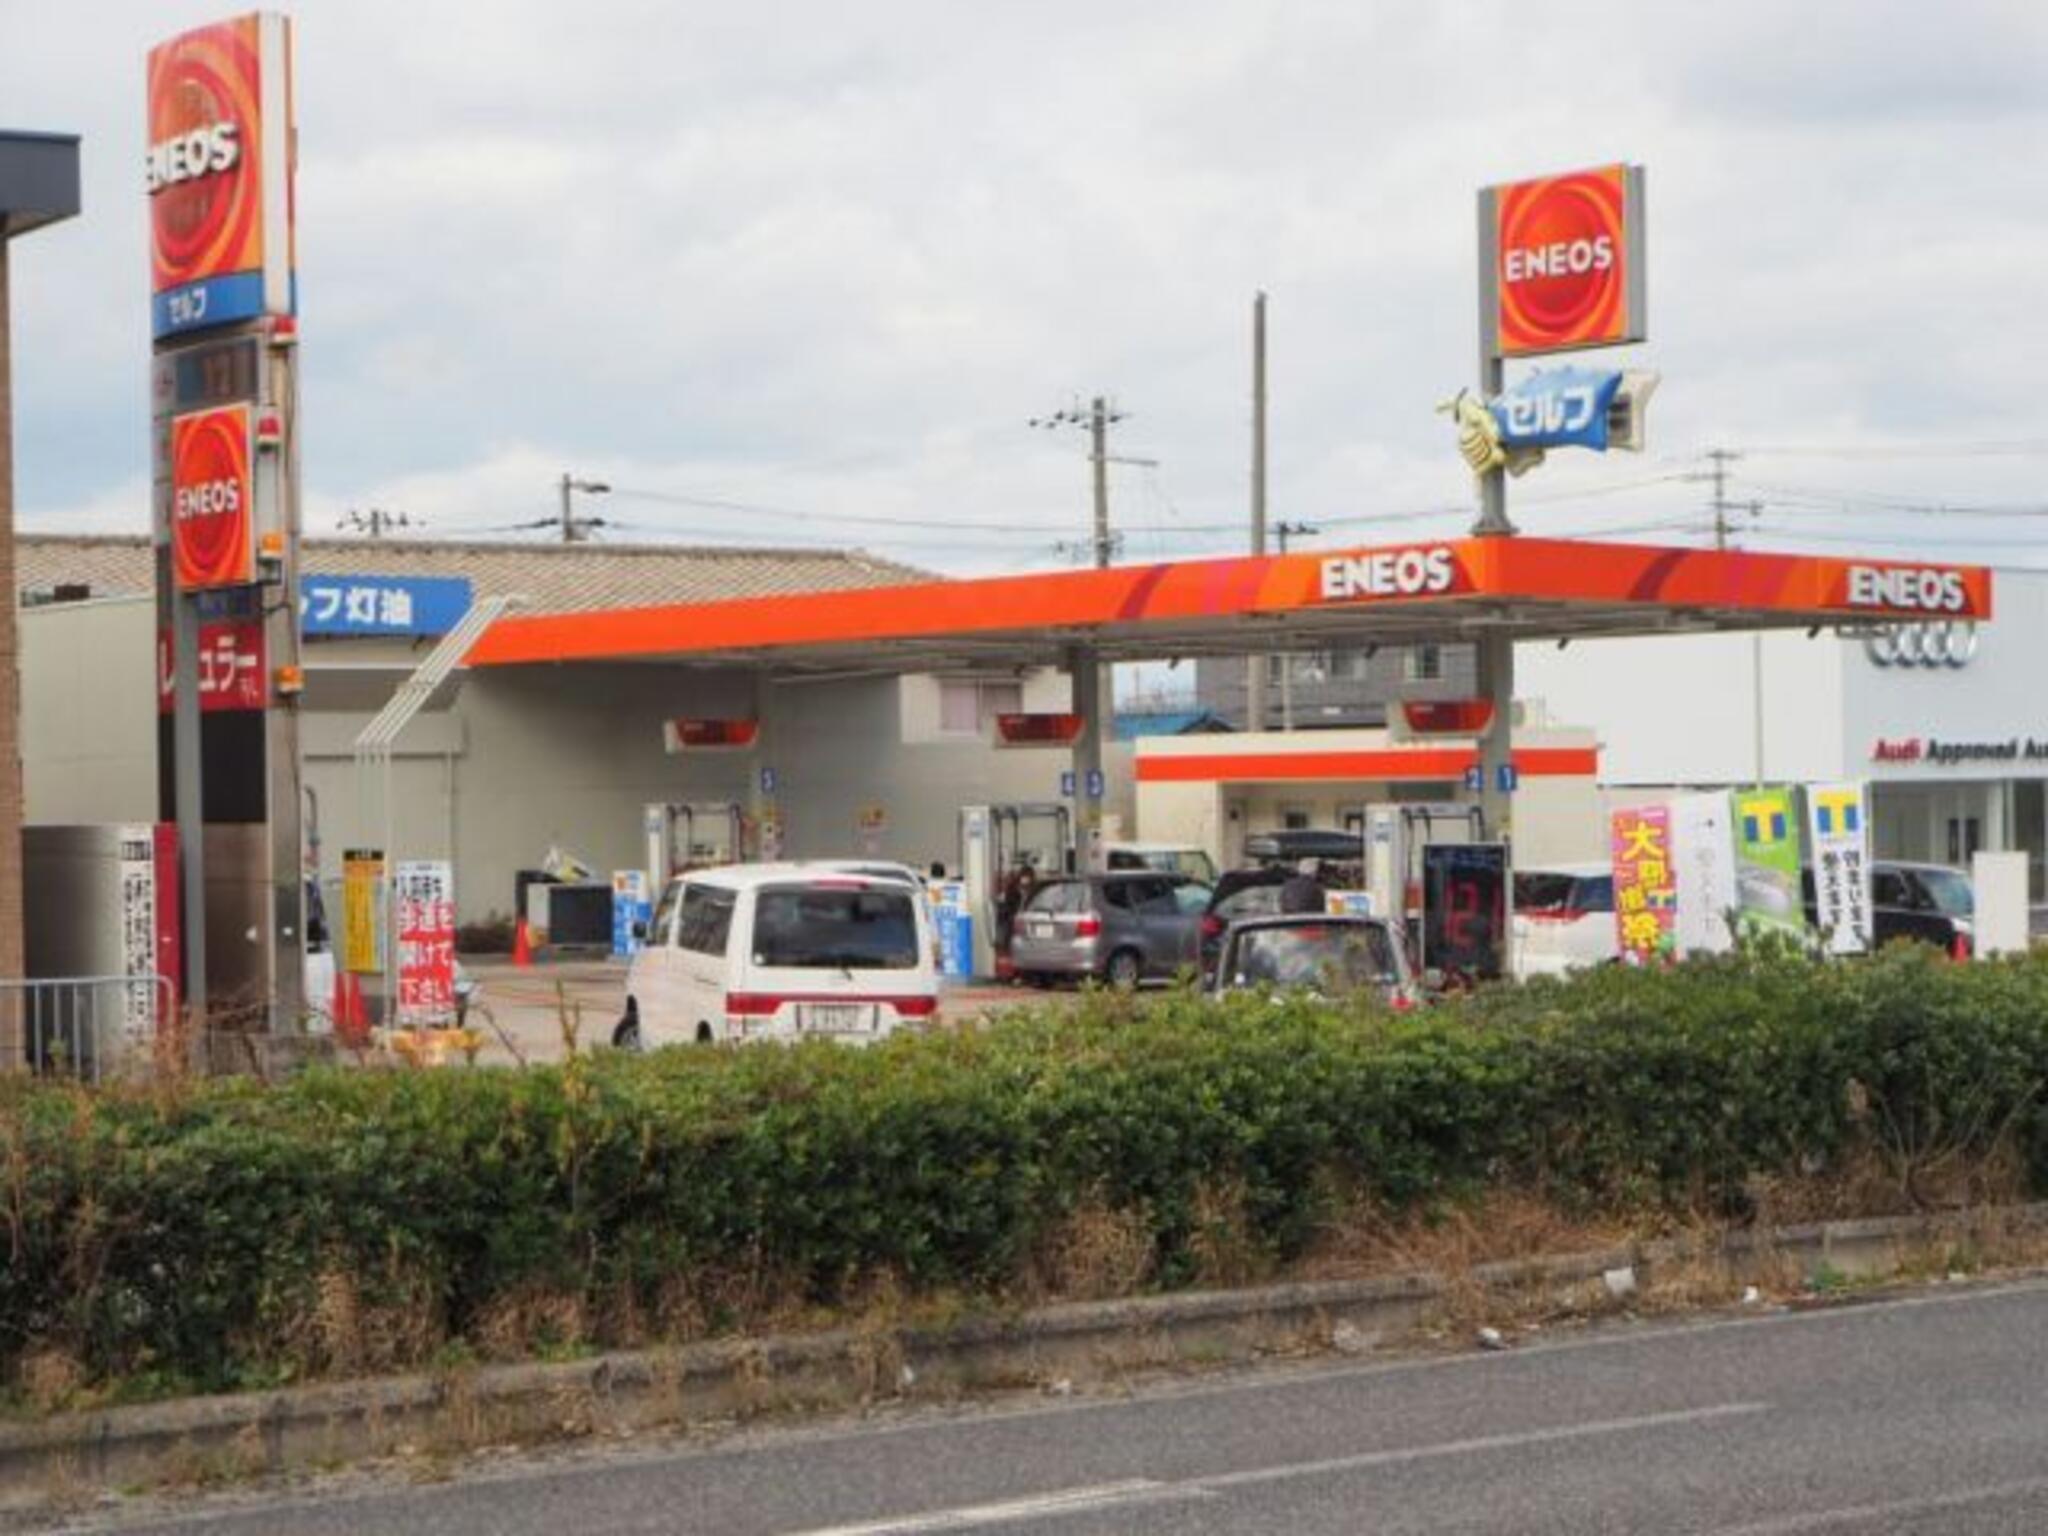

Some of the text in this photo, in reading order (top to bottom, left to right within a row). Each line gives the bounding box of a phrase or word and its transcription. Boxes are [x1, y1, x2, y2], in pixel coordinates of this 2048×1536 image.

[1505, 236, 1612, 282] ENEOS
[1507, 386, 1595, 436] セルフ
[177, 477, 239, 519] ENEOS
[1321, 547, 1454, 597] ENEOS
[1847, 565, 1964, 611] ENEOS
[1875, 738, 1921, 761] Audi
[1927, 738, 2017, 765] Approved
